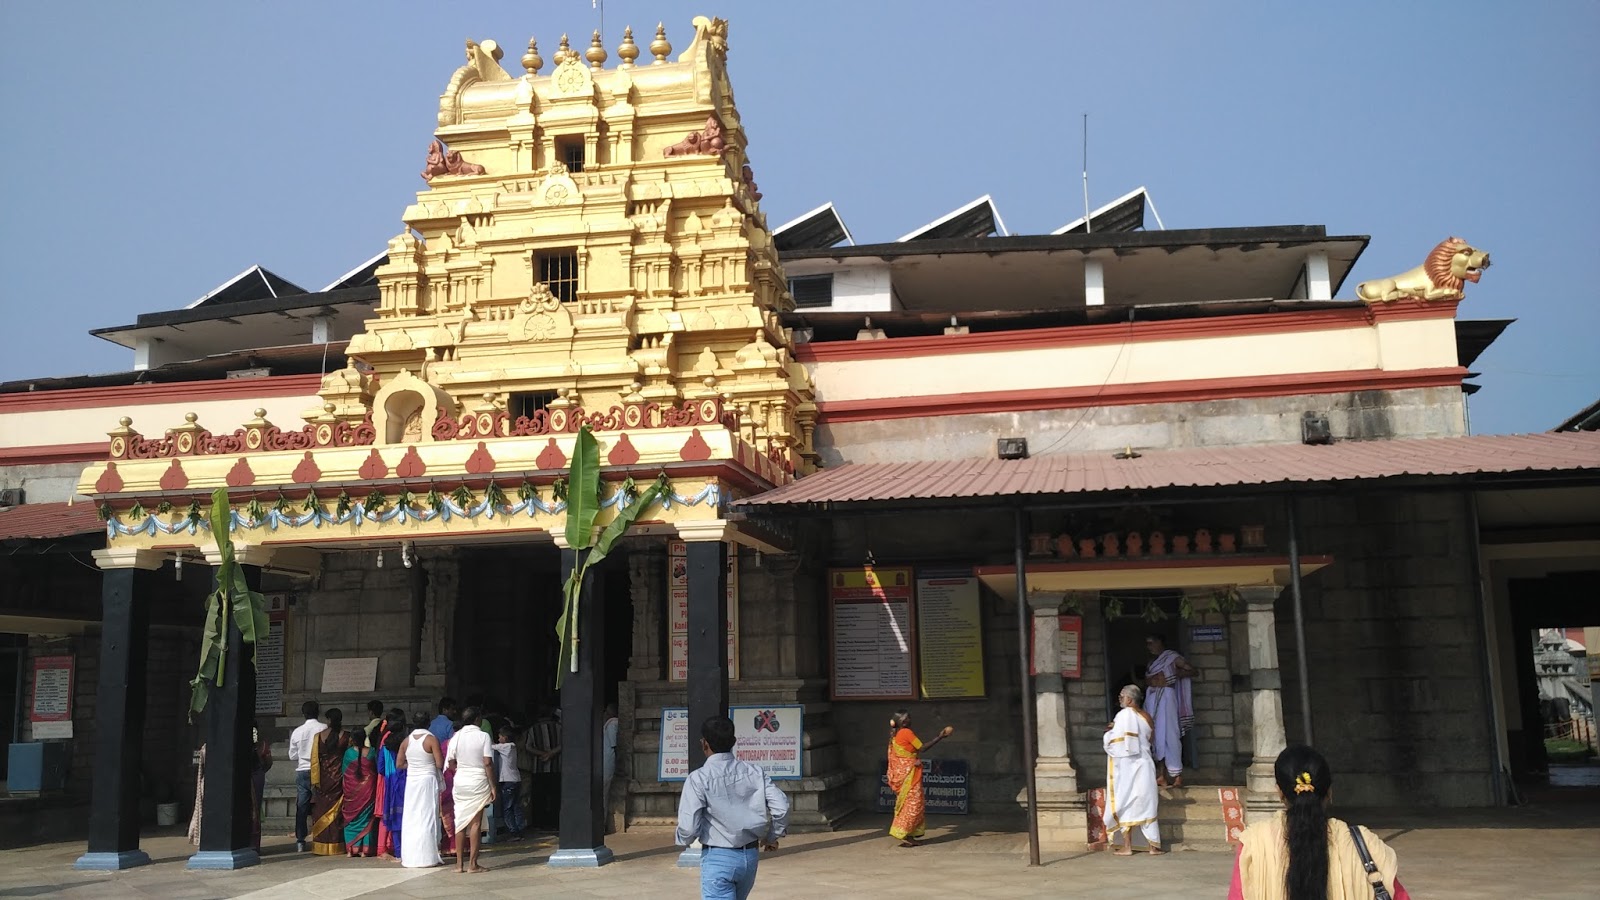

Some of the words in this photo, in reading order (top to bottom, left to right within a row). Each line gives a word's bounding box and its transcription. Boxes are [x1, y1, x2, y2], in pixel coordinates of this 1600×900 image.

[736, 749, 769, 761] PHOTOGRAPHY
[770, 749, 796, 761] PROHIBITED
[928, 787, 966, 796] PROHIBITED
